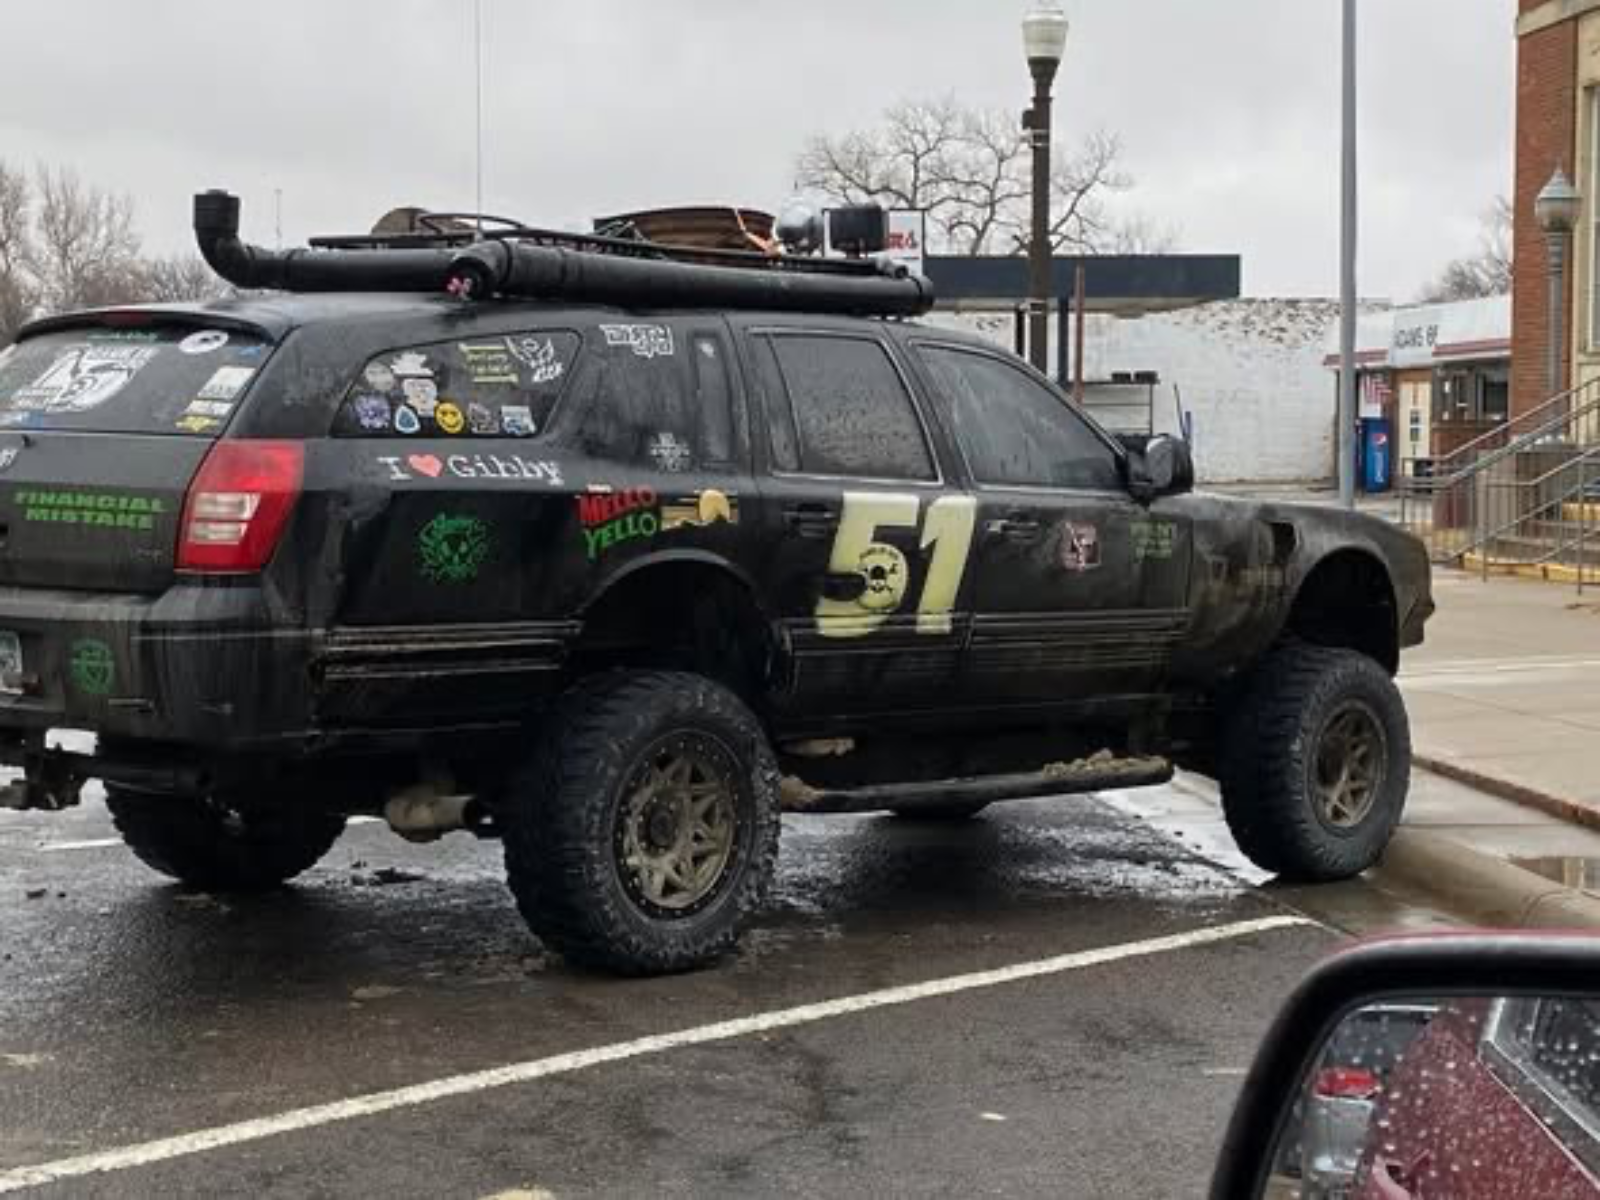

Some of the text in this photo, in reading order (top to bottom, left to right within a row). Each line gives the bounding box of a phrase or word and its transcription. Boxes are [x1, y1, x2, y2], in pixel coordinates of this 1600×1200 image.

[377, 455, 565, 486] I Gibby
[15, 491, 167, 512] FINANCIAL
[25, 508, 153, 529] MISTAKE
[576, 486, 657, 536] MELLO
[583, 512, 657, 559] YELLO
[815, 492, 977, 636] 51
